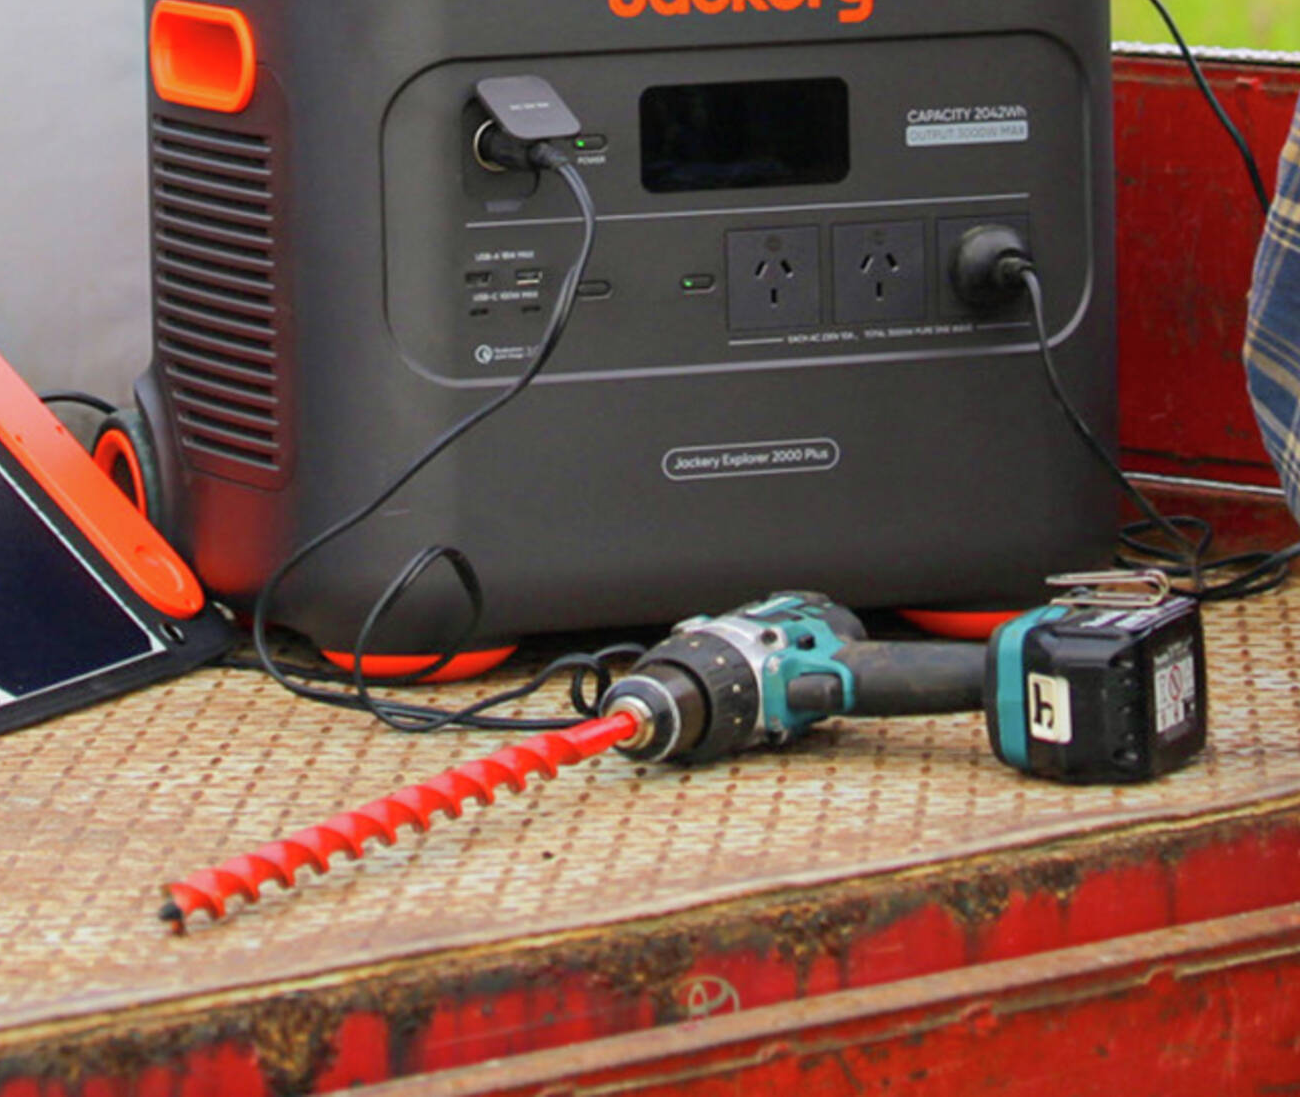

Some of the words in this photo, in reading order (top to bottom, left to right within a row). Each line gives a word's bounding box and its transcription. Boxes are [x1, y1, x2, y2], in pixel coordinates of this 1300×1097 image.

[906, 107, 971, 123] CAPACITY
[673, 456, 720, 470] Jackery
[722, 453, 770, 467] Explorer
[771, 449, 803, 463] 2000
[804, 447, 829, 461] Plus
